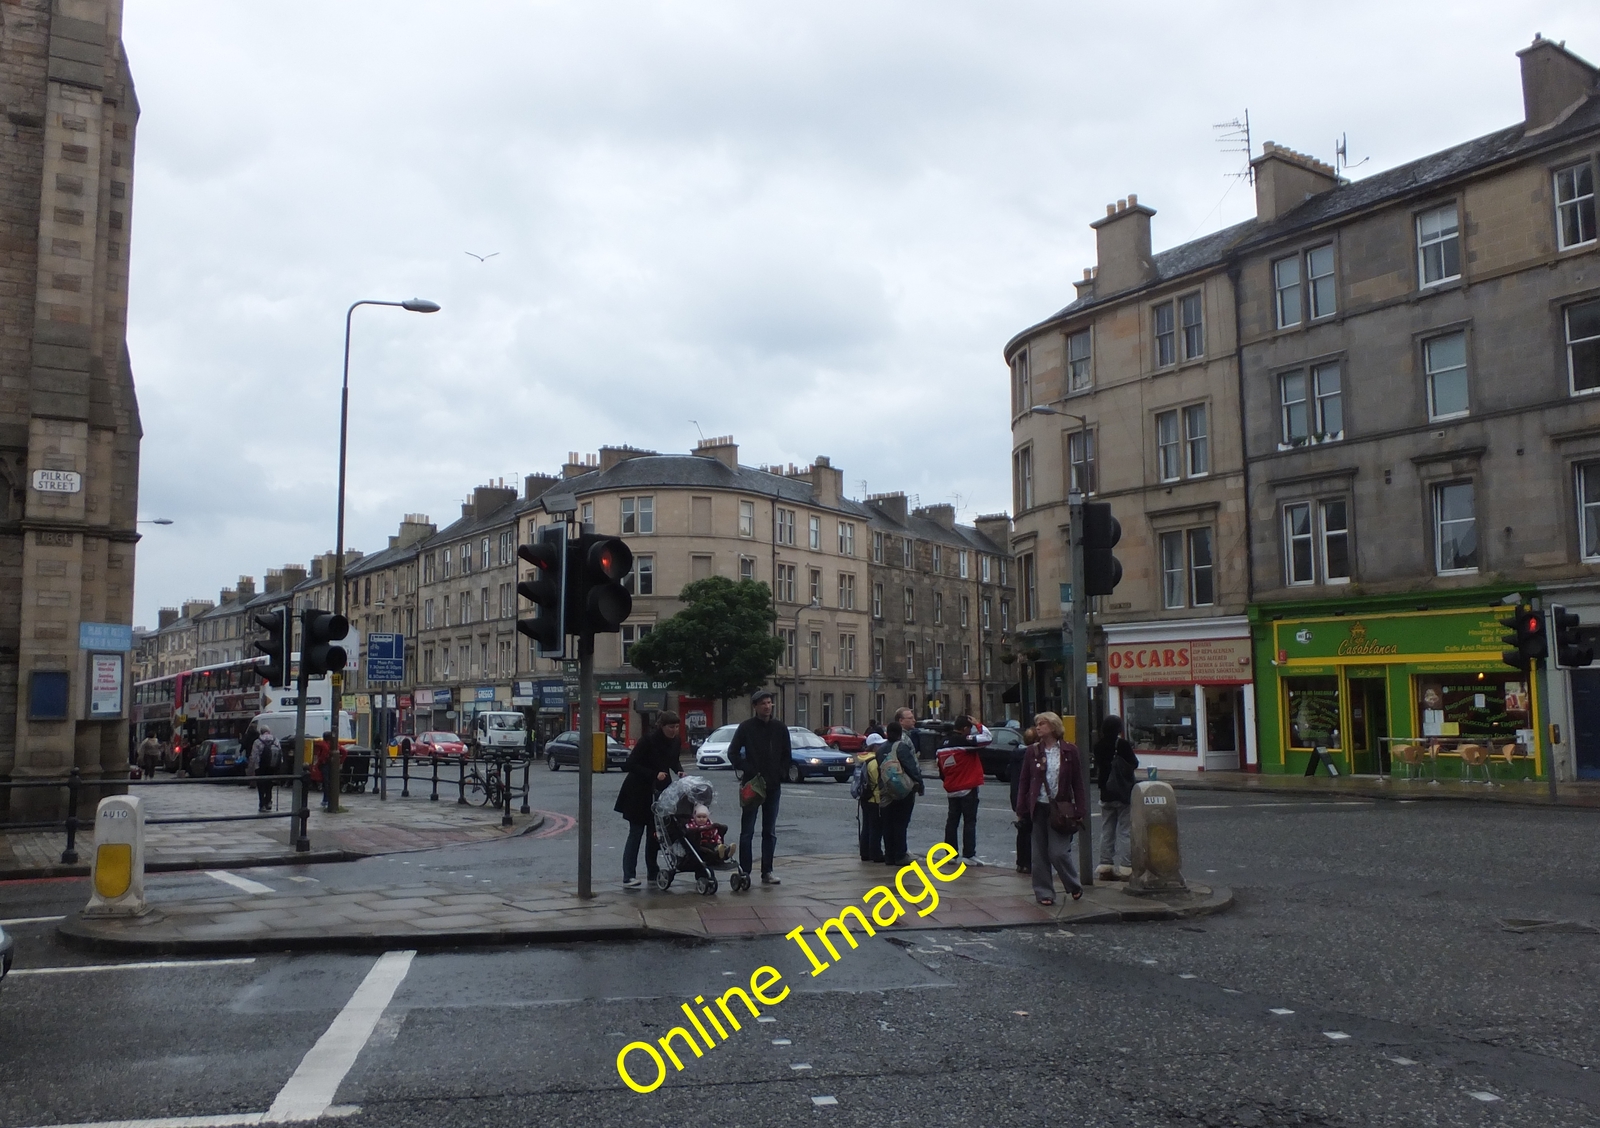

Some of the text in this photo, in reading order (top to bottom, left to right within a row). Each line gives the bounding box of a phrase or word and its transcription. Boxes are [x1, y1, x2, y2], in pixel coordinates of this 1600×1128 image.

[41, 471, 73, 482] PILRIG
[38, 480, 75, 491] STREET
[1337, 639, 1398, 656] Casablanca
[1109, 648, 1190, 669] OSCARS
[625, 681, 648, 689] LEITH
